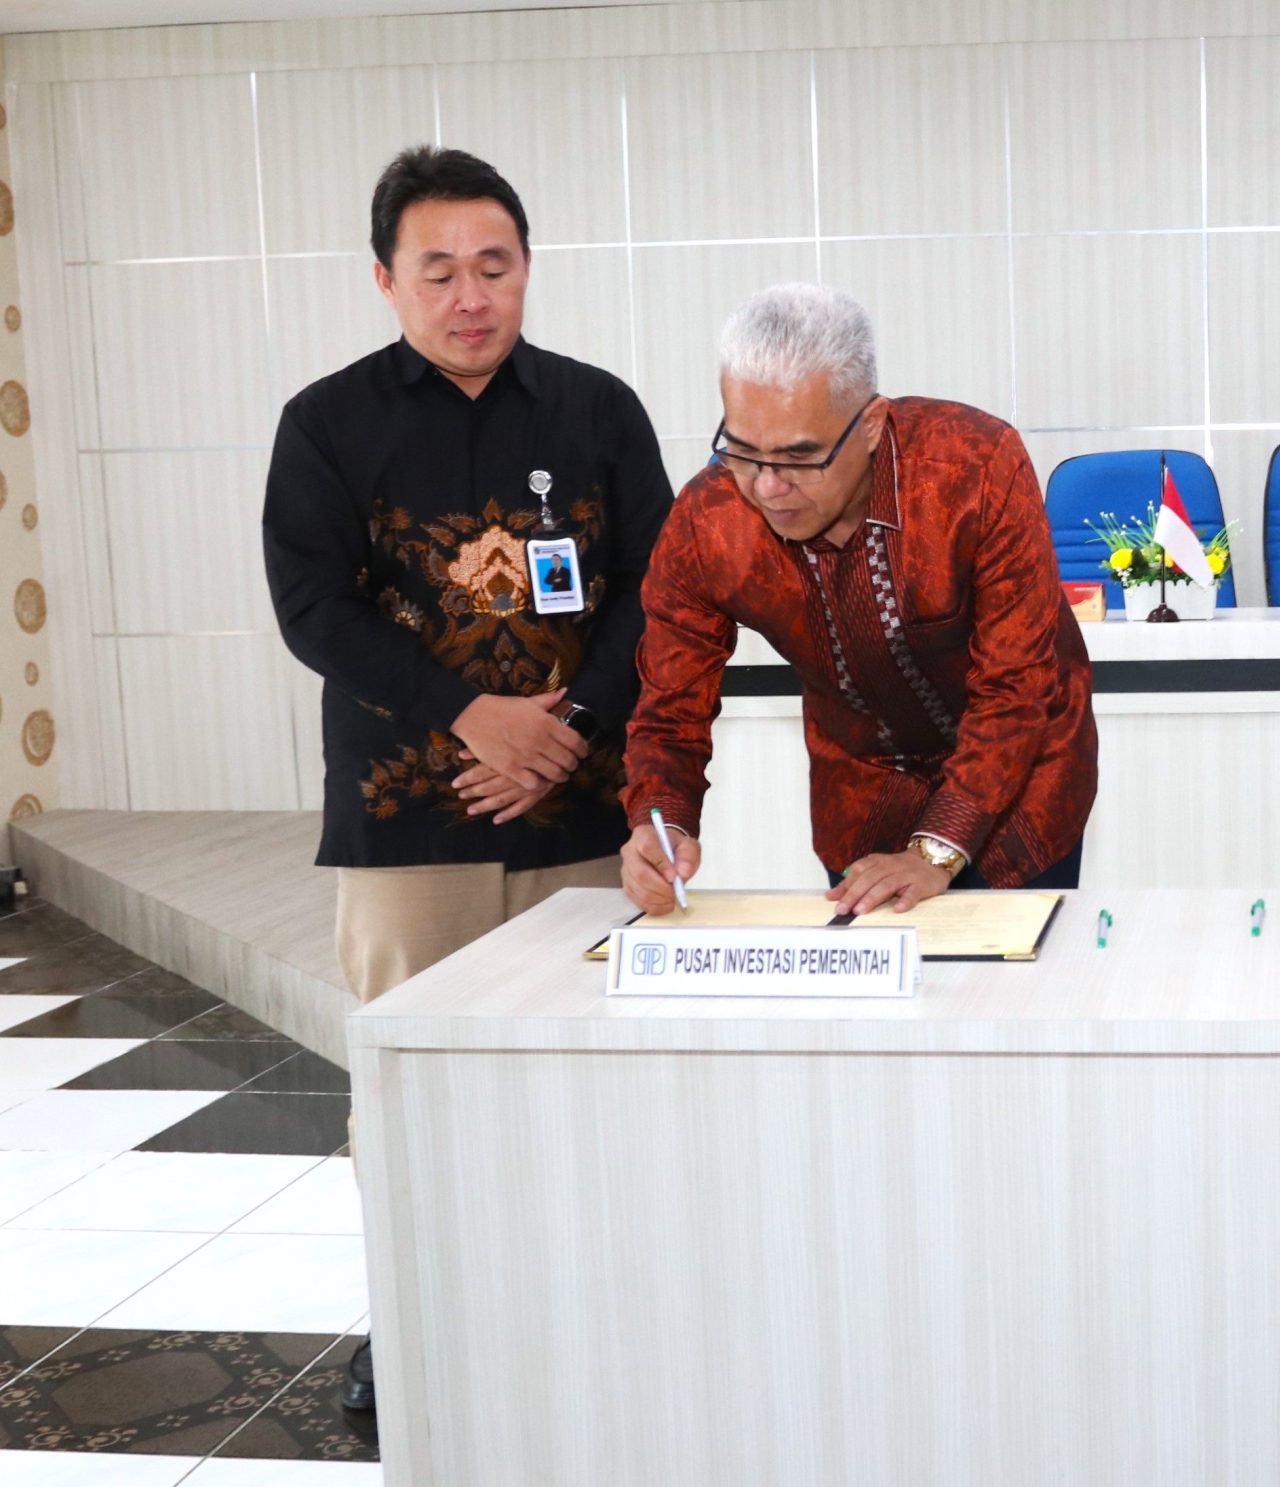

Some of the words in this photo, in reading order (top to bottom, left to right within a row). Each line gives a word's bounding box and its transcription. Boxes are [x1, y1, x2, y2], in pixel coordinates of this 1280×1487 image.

[674, 948, 721, 973] PUSAT
[723, 948, 797, 975] INVESTASI
[798, 949, 890, 975] PEMERINTAH
